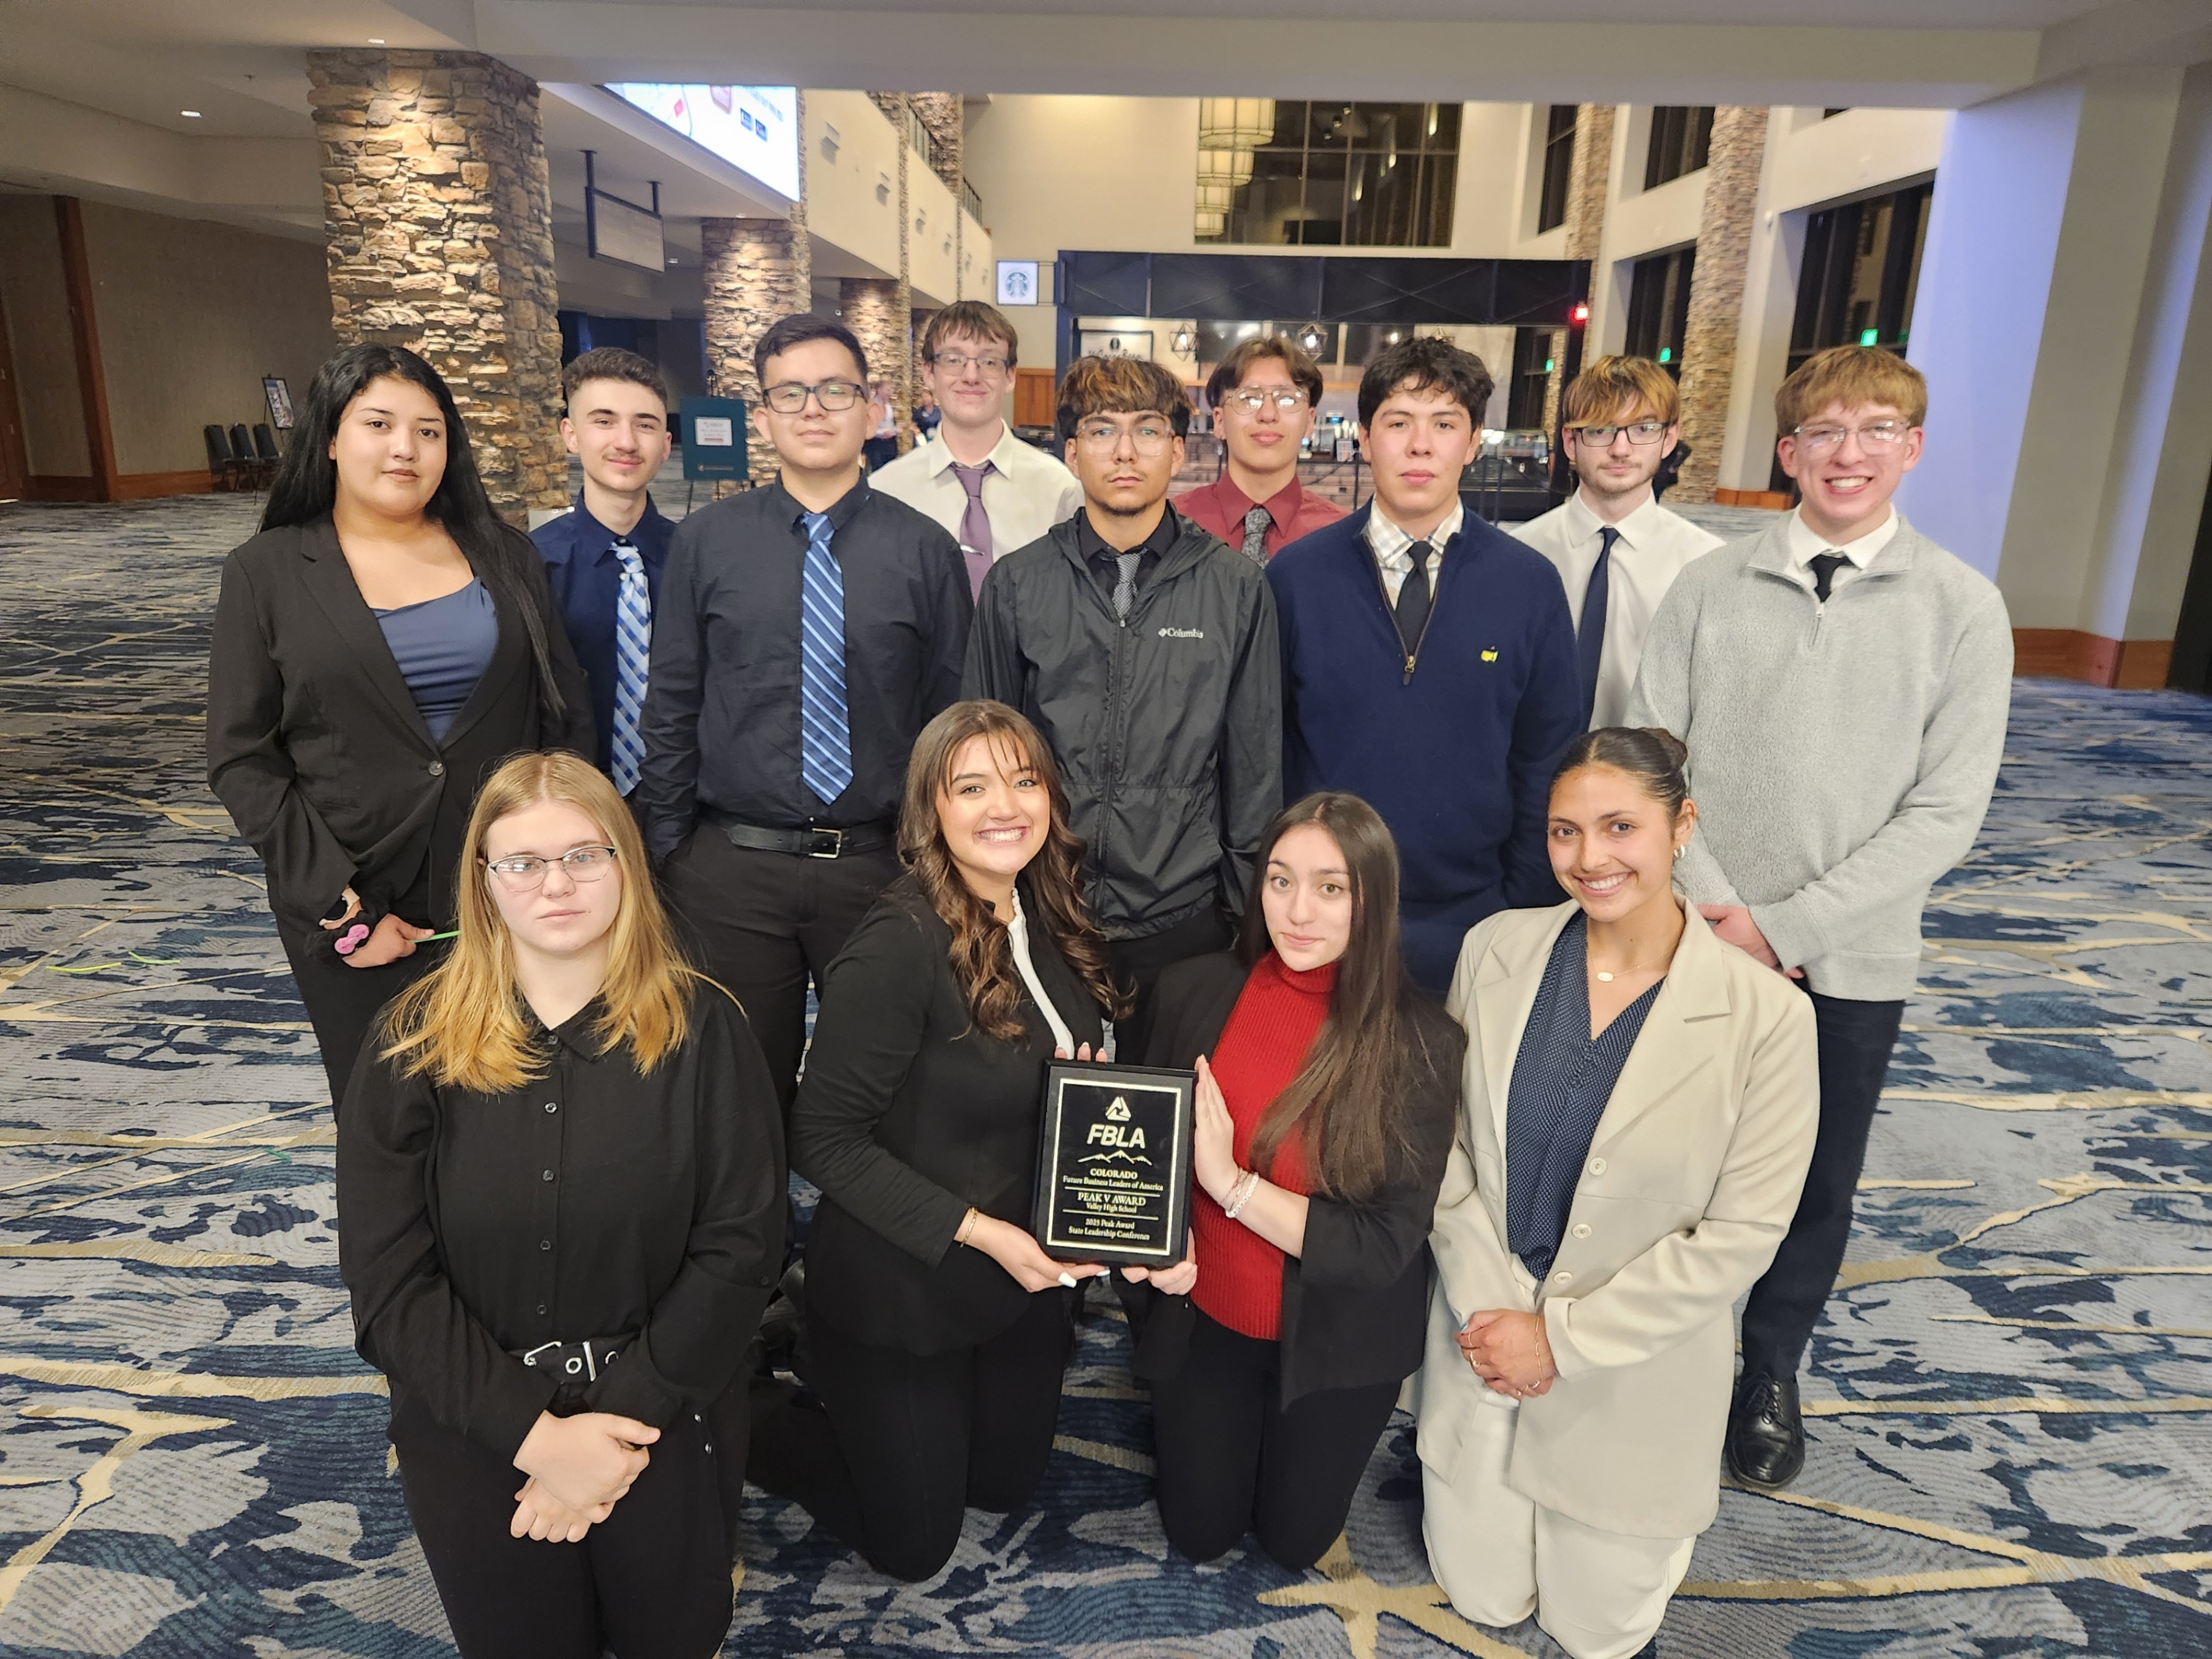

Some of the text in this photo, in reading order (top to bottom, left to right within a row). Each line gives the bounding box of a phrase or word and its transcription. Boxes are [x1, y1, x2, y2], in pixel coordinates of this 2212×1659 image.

[1167, 628, 1203, 639] Columbia
[1086, 1123, 1145, 1149] FBLA
[1090, 1168, 1138, 1179] COLORADO
[1062, 1175, 1083, 1184] Future
[1084, 1177, 1108, 1186] Business
[1109, 1179, 1131, 1188] Leaders
[1139, 1182, 1164, 1191] America
[1078, 1192, 1146, 1205] PEAK V AWARD
[1086, 1202, 1102, 1212] Valley
[1103, 1204, 1118, 1213] High
[1116, 1221, 1135, 1229] Award
[1085, 1227, 1116, 1239] Leadership
[1117, 1231, 1150, 1240] Conference
